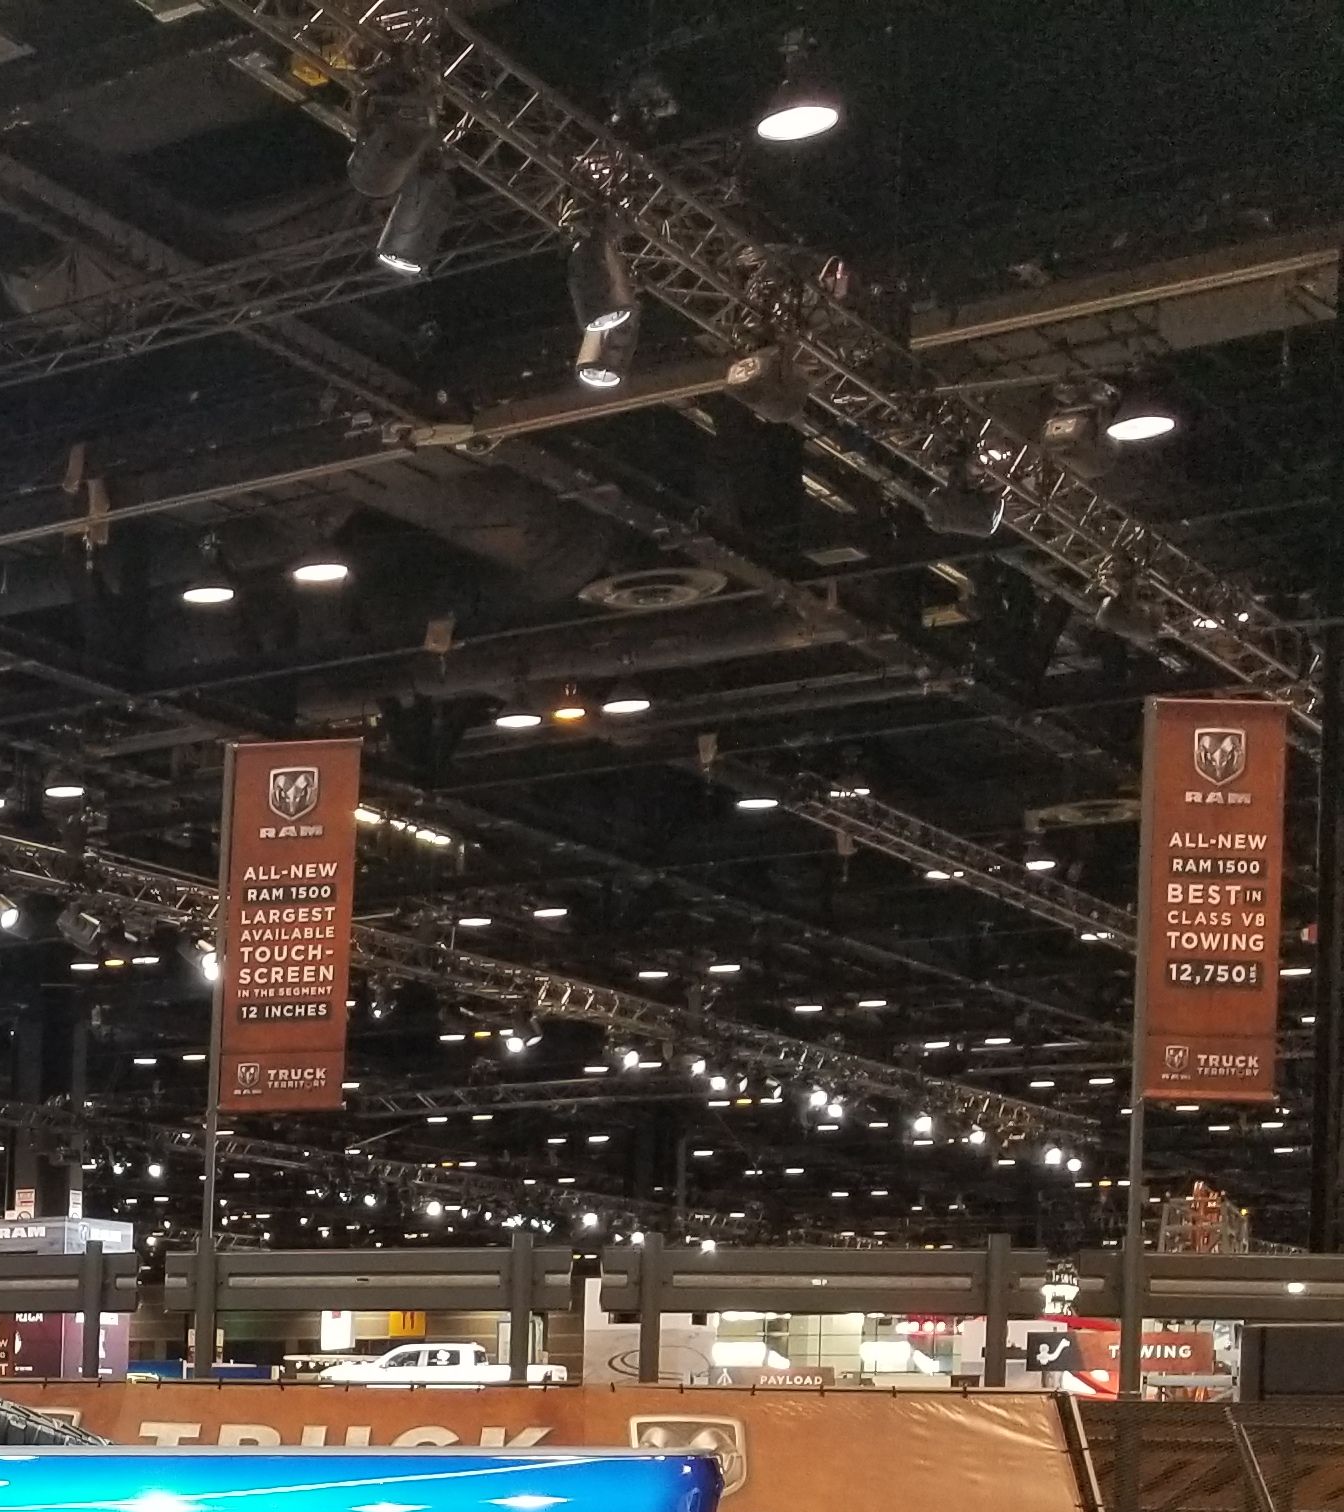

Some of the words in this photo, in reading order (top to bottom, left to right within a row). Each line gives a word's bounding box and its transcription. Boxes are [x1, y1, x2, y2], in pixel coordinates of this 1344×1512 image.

[1185, 791, 1251, 803] RAM
[259, 825, 323, 839] RAM
[1169, 833, 1267, 850] ALL-NEW
[244, 862, 337, 881] ALL-NEW
[1173, 859, 1212, 873] RAM
[1218, 860, 1260, 875] 1500
[247, 888, 283, 901] RAM
[291, 885, 331, 900] 1500
[1167, 883, 1241, 905] BEST
[1246, 890, 1262, 902] IN
[241, 907, 336, 925] LARGEST
[1167, 910, 1231, 926] CLASS
[1241, 912, 1265, 927] V8
[240, 926, 335, 942] AVAILABLE
[1166, 931, 1265, 952] TOWING
[240, 944, 334, 963] TOUCH-
[238, 965, 334, 984] SCREEN
[1169, 963, 1246, 985] 12,750
[237, 989, 250, 998] IN
[254, 988, 275, 998] THE
[278, 986, 333, 997] SEGMENT
[241, 1006, 258, 1019] 12
[264, 1003, 327, 1018] INCHES
[1196, 1054, 1260, 1068] TRUCK
[267, 1067, 327, 1080] TRUCK
[1108, 1344, 1192, 1359] TWING
[759, 1374, 824, 1386] PAYLOAD
